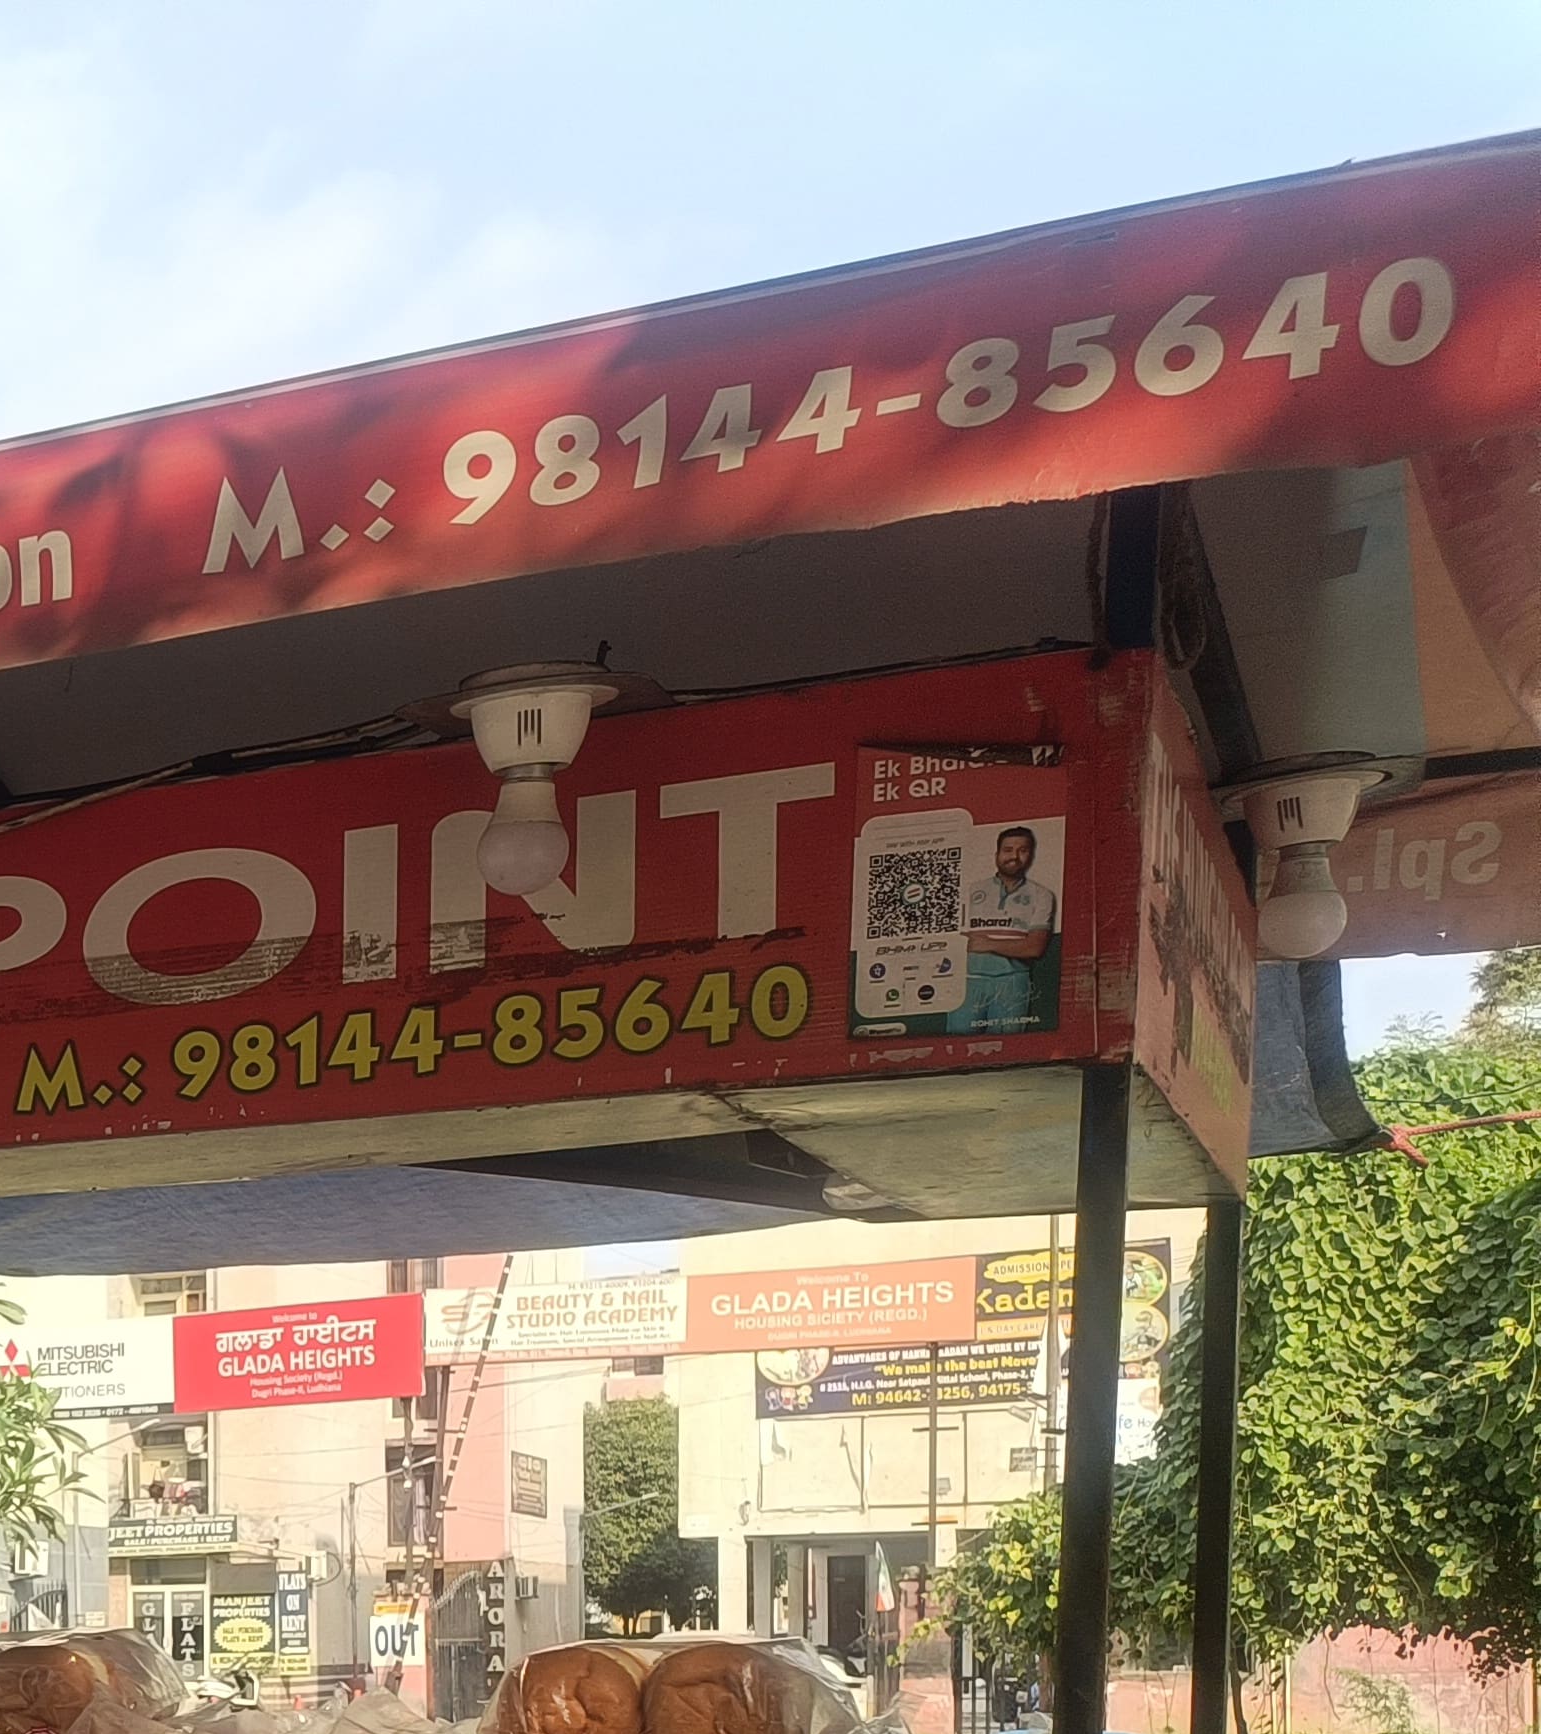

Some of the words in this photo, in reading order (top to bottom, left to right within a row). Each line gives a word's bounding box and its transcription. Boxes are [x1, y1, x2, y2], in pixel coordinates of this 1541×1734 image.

[203, 465, 396, 574] M.:
[442, 256, 1457, 527] 98144-85640
[874, 760, 900, 780] Ek
[873, 782, 899, 802] Ek
[909, 778, 946, 798] QR
[16, 1040, 143, 1114] M.:
[171, 963, 810, 1101] 98144-85640
[993, 1263, 1050, 1275] ADMISSION
[517, 1295, 594, 1311] BEAUTY
[601, 1293, 614, 1306] &
[623, 1290, 667, 1306] NAIL
[711, 1290, 813, 1316] GLADA
[822, 1281, 954, 1310] HEIGHTS
[507, 1311, 576, 1329] STUDIO
[584, 1306, 678, 1326] ACADEMY
[734, 1312, 803, 1330] HOUSING
[38, 1342, 125, 1361] MITSUBISHI
[218, 1354, 285, 1377] GLADA
[290, 1345, 375, 1371] HEIGHTS
[37, 1360, 113, 1377] ELECTRIC
[145, 1522, 234, 1537] PROPERTIES
[279, 1573, 306, 1591] FLATS
[286, 1594, 300, 1610] ON
[281, 1615, 306, 1632] RENT
[375, 1624, 419, 1656] OUT
